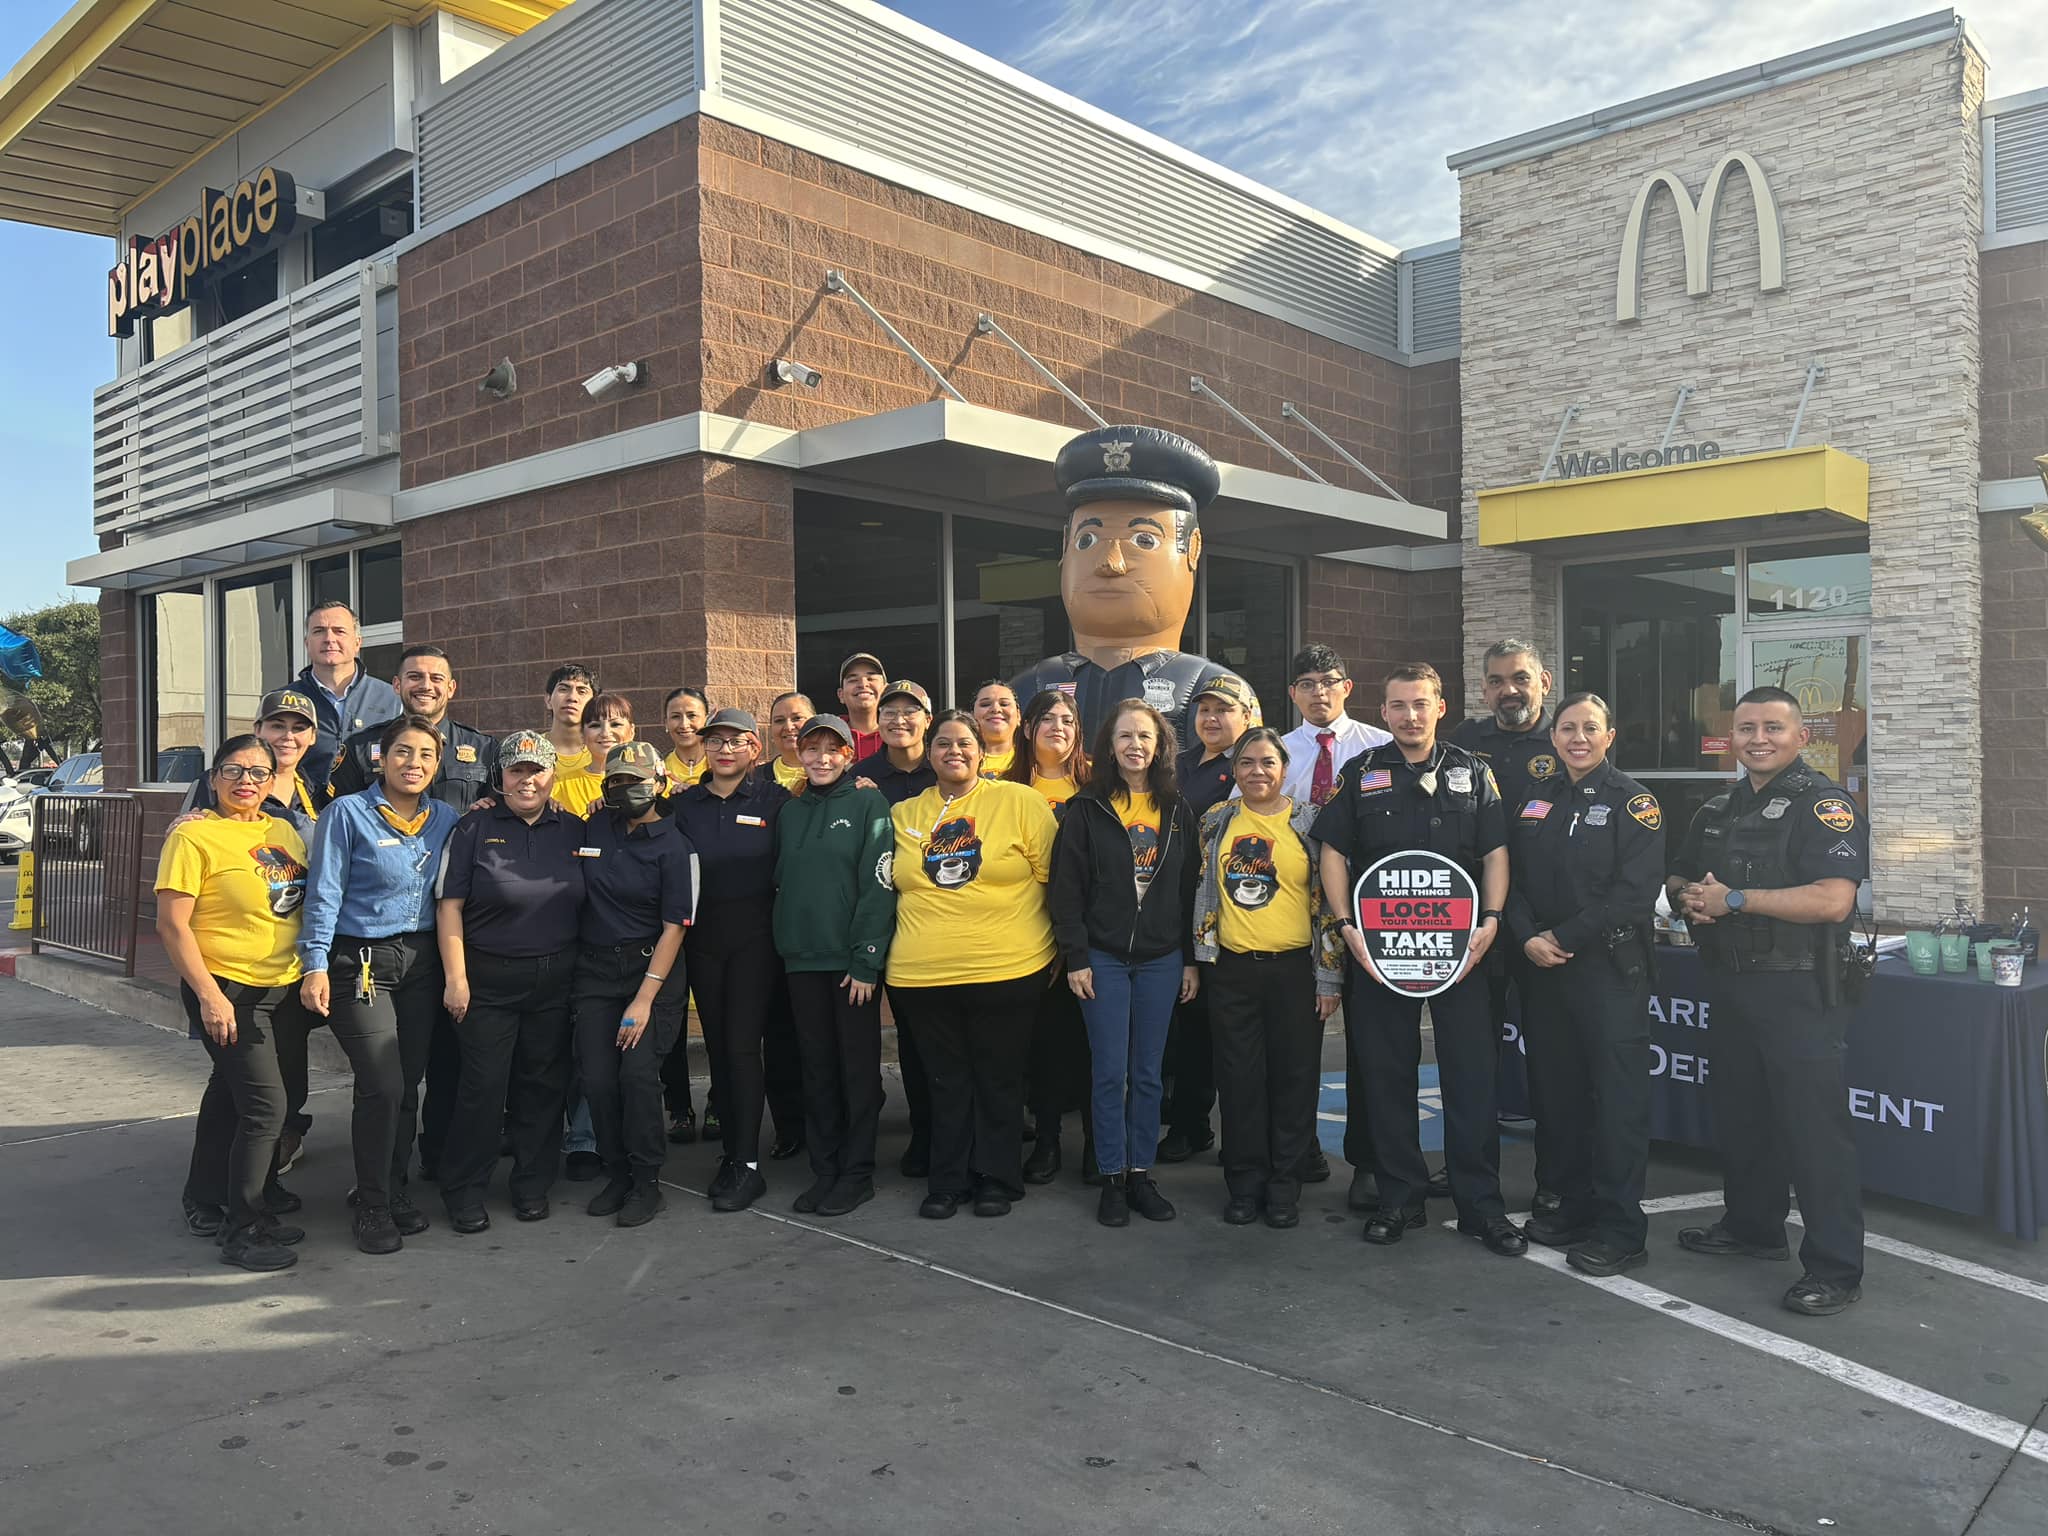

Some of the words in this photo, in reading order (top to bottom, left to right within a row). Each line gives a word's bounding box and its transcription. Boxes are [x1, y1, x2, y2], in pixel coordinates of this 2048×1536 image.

[109, 166, 279, 336] playplace
[1555, 440, 1721, 480] Welcome
[1770, 586, 1848, 610] 1120
[1379, 869, 1452, 889] HIDE
[1381, 888, 1409, 896] YOUR
[1411, 888, 1451, 896] THINGS
[1380, 902, 1452, 918] LOCK
[1381, 918, 1408, 926] YOUR
[1410, 918, 1453, 926] VEHICLE
[1380, 932, 1454, 949] TAKE
[1381, 948, 1415, 957] YOUR
[1420, 948, 1453, 957] KEYS
